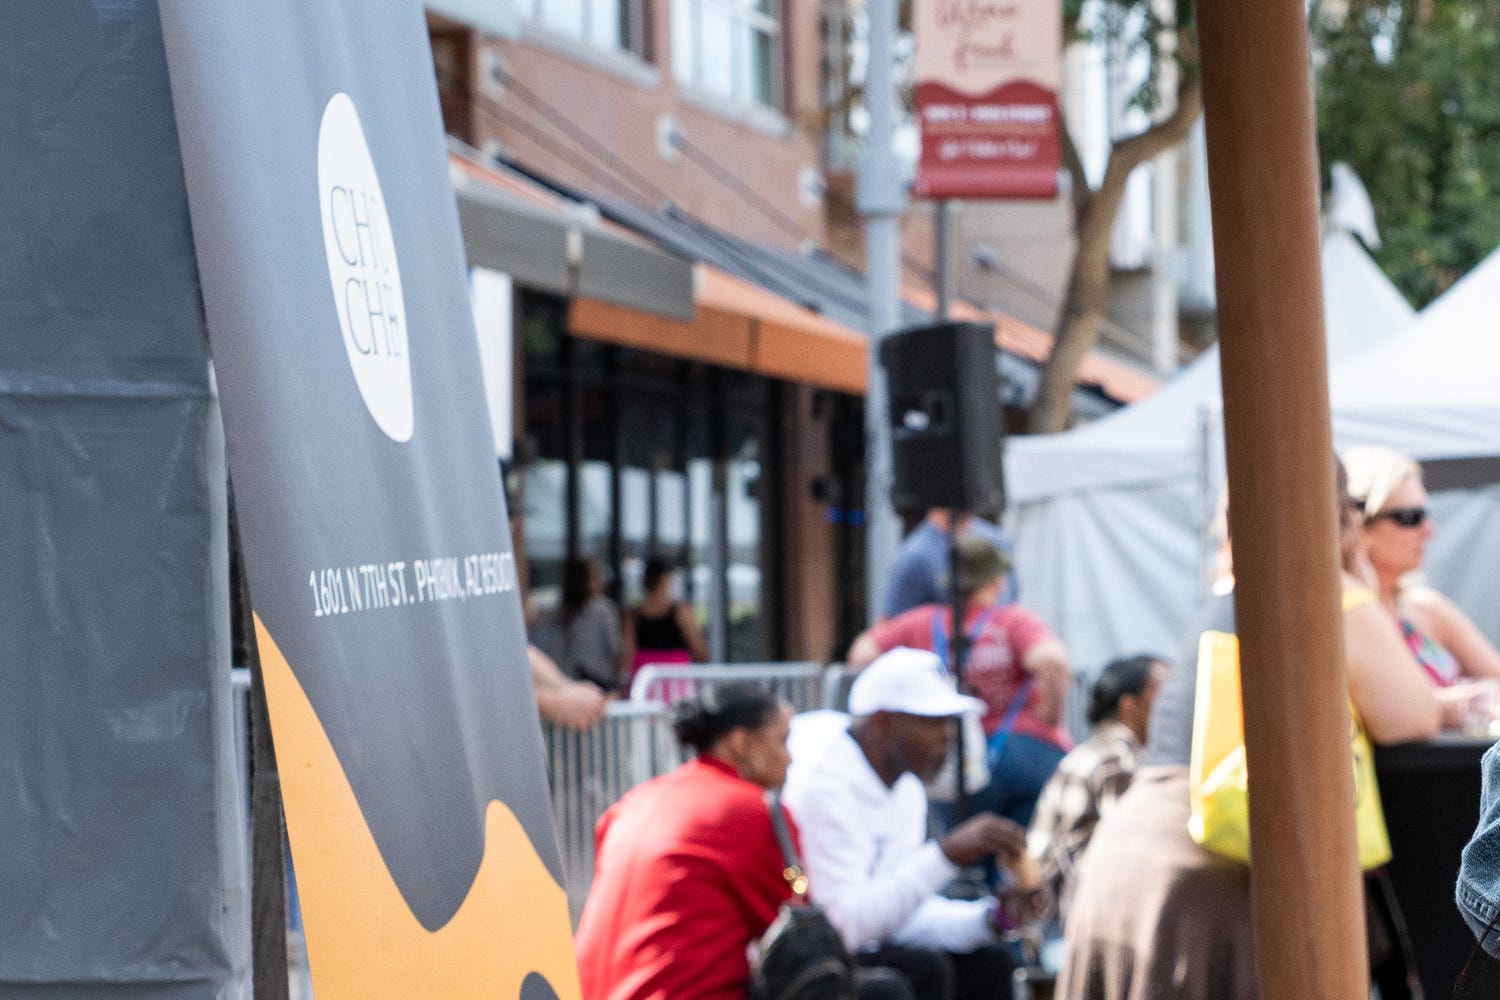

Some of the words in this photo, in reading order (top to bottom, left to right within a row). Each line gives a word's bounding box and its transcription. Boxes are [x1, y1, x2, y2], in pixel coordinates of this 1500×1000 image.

[309, 569, 349, 617] 1601
[346, 565, 362, 611] N
[359, 563, 390, 609] 7TH
